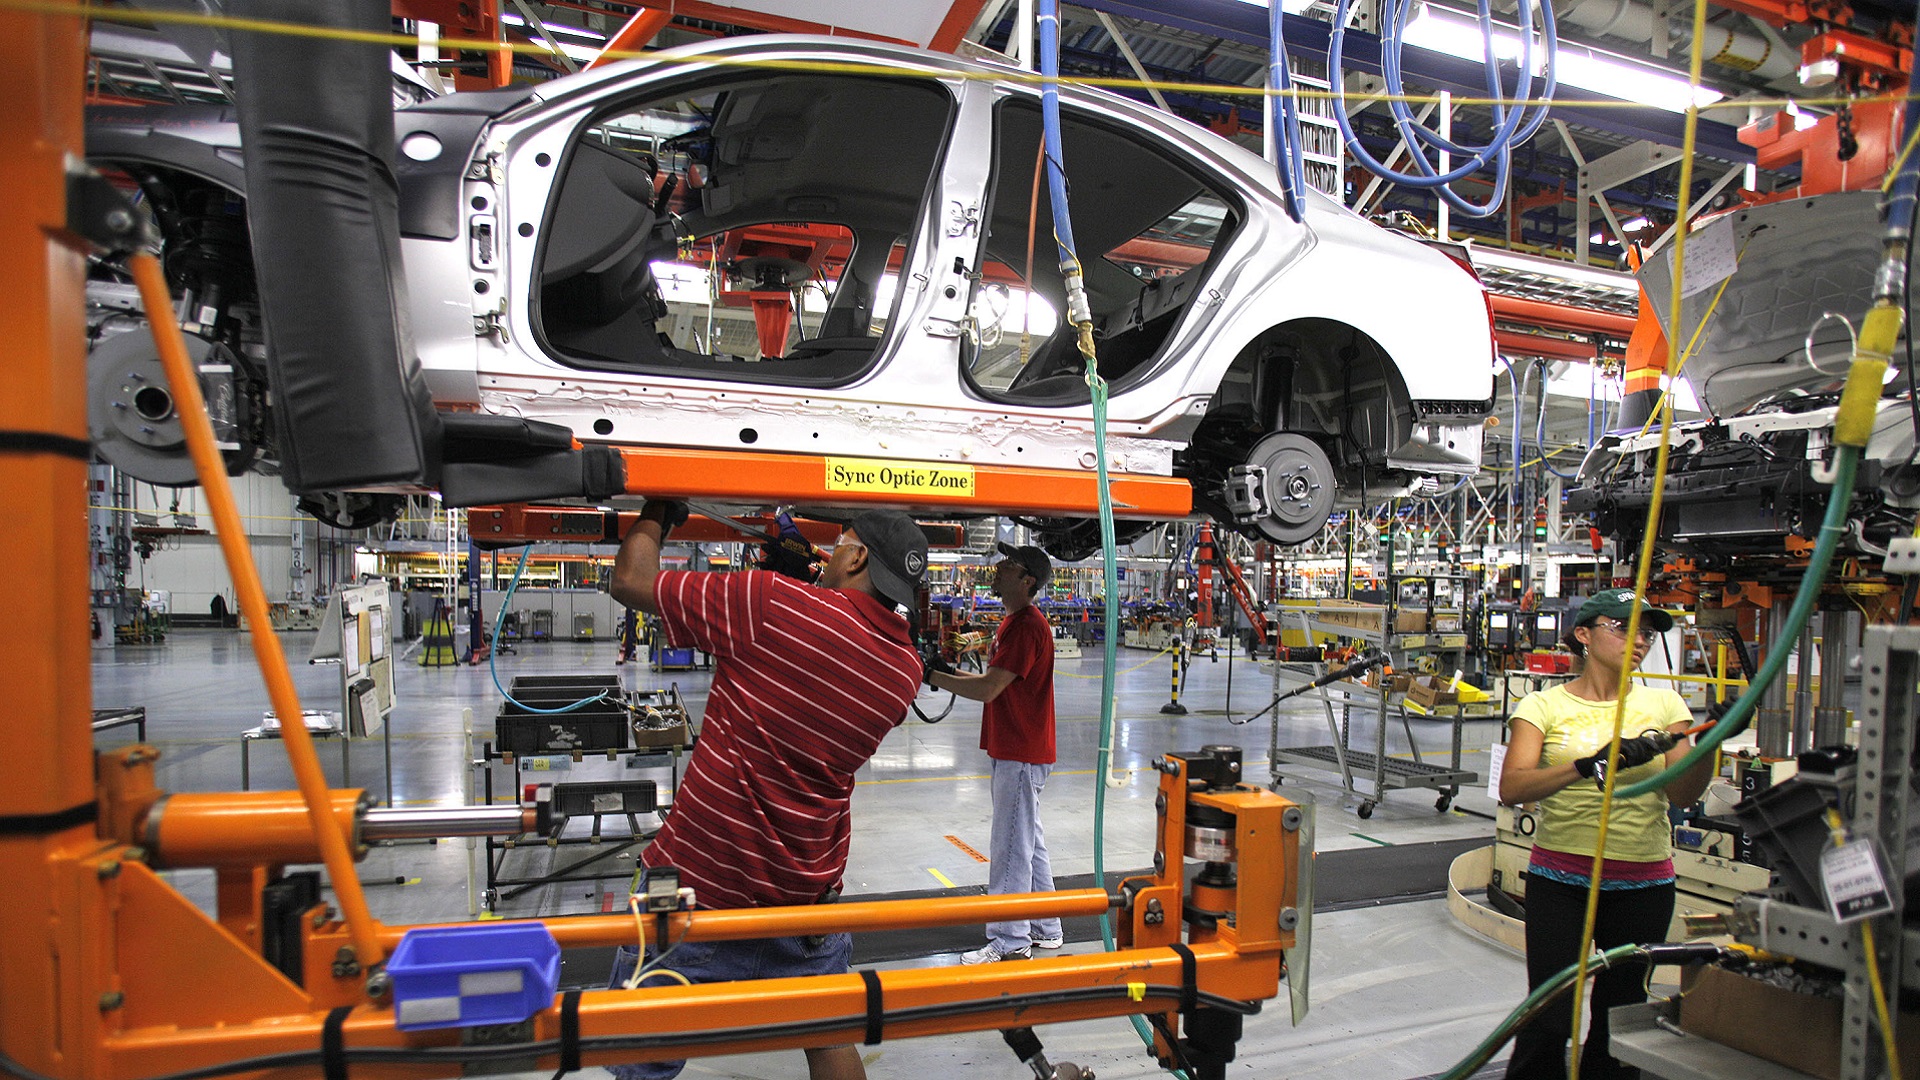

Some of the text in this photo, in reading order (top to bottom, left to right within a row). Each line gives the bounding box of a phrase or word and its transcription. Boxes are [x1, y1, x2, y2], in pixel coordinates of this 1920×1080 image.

[834, 465, 968, 489] Sync Optic Zone
[784, 537, 807, 552] IRWIN
[1334, 613, 1349, 624] A13
[1745, 776, 1755, 791] 3
